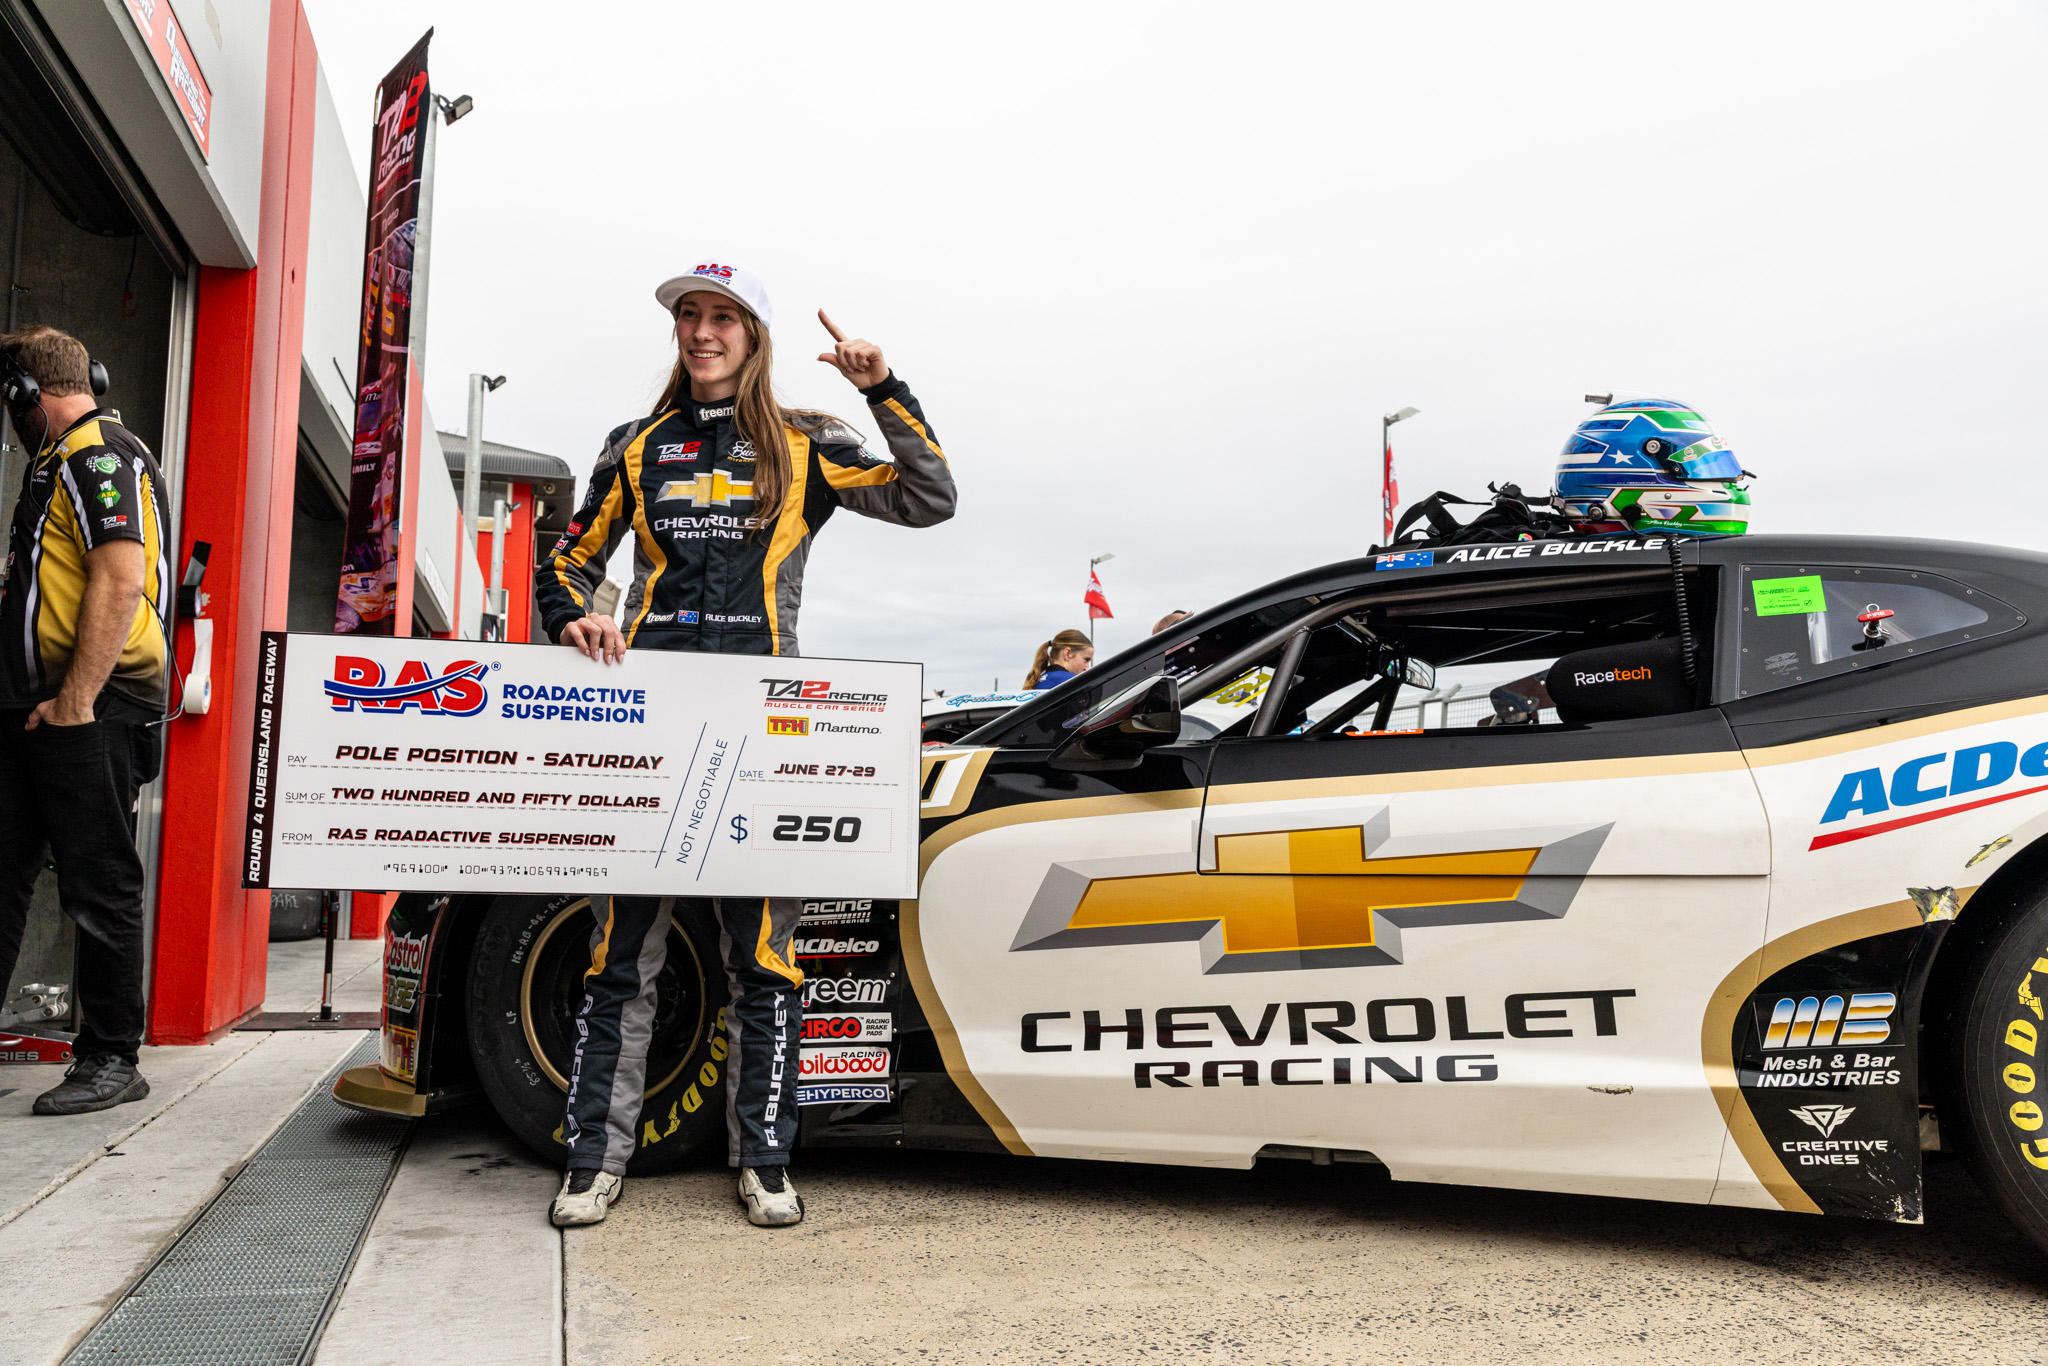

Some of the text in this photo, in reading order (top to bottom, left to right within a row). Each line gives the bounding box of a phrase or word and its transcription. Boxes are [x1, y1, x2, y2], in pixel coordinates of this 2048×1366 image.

[379, 71, 428, 157] TA2
[693, 263, 735, 279] RAS
[699, 405, 734, 421] freem
[657, 441, 702, 454] TA2
[659, 452, 698, 460] RACING
[101, 490, 117, 498] ASP
[101, 515, 128, 523] TA2
[673, 531, 744, 540] RACING
[1447, 544, 1535, 564] ALICE
[645, 612, 676, 624] freem
[705, 613, 762, 623] ALICE BUCKLEY
[1867, 610, 1886, 619] FIRE
[1574, 665, 1652, 686] Racetech
[324, 655, 490, 718] RAS
[502, 683, 646, 705] ROADACTIVE
[759, 678, 889, 702] TA2 RACING
[501, 703, 645, 723] SUSPENSION
[764, 702, 813, 710] MUSCLE
[842, 705, 885, 713] SERIES
[769, 718, 804, 733] TFH
[249, 637, 278, 883] ROUND 4 QUEENSLAND RACEWAY
[288, 755, 308, 764] PAY
[336, 745, 399, 761] POLE
[407, 747, 518, 765] POSITION
[543, 752, 664, 770] SATURDAY
[739, 770, 764, 778] DATE
[774, 763, 876, 777] JUNE 27-29
[1819, 741, 2048, 825] ACDe
[285, 792, 326, 801] SUM OF
[331, 787, 661, 808] TWO HUNDRED AND FIFTY DOLLARS
[676, 739, 729, 864] NOT NEGOTIABLE
[282, 832, 313, 842] FROM
[327, 827, 616, 846] RAS ROADACTIVE SUSPENSION
[729, 814, 862, 844] $ 250
[802, 899, 873, 913] ACING
[386, 930, 428, 975] Castrol
[794, 937, 880, 954] ACDelco
[803, 977, 887, 1004] reem
[1020, 988, 1637, 1053] CHEVROLET
[0, 1051, 39, 1061] RIES
[765, 991, 787, 1122] BUCKLEY
[799, 1052, 887, 1075] wilwood
[840, 1051, 883, 1059] RACING
[1763, 1053, 1895, 1071] Mesh & Bar
[1134, 1054, 1499, 1089] RACING
[1756, 1070, 1901, 1088] INDUSTRIES
[566, 1018, 590, 1149] BUCKLEY
[1782, 1140, 1888, 1152] CREATIVE
[1800, 1154, 1860, 1166] ONES
